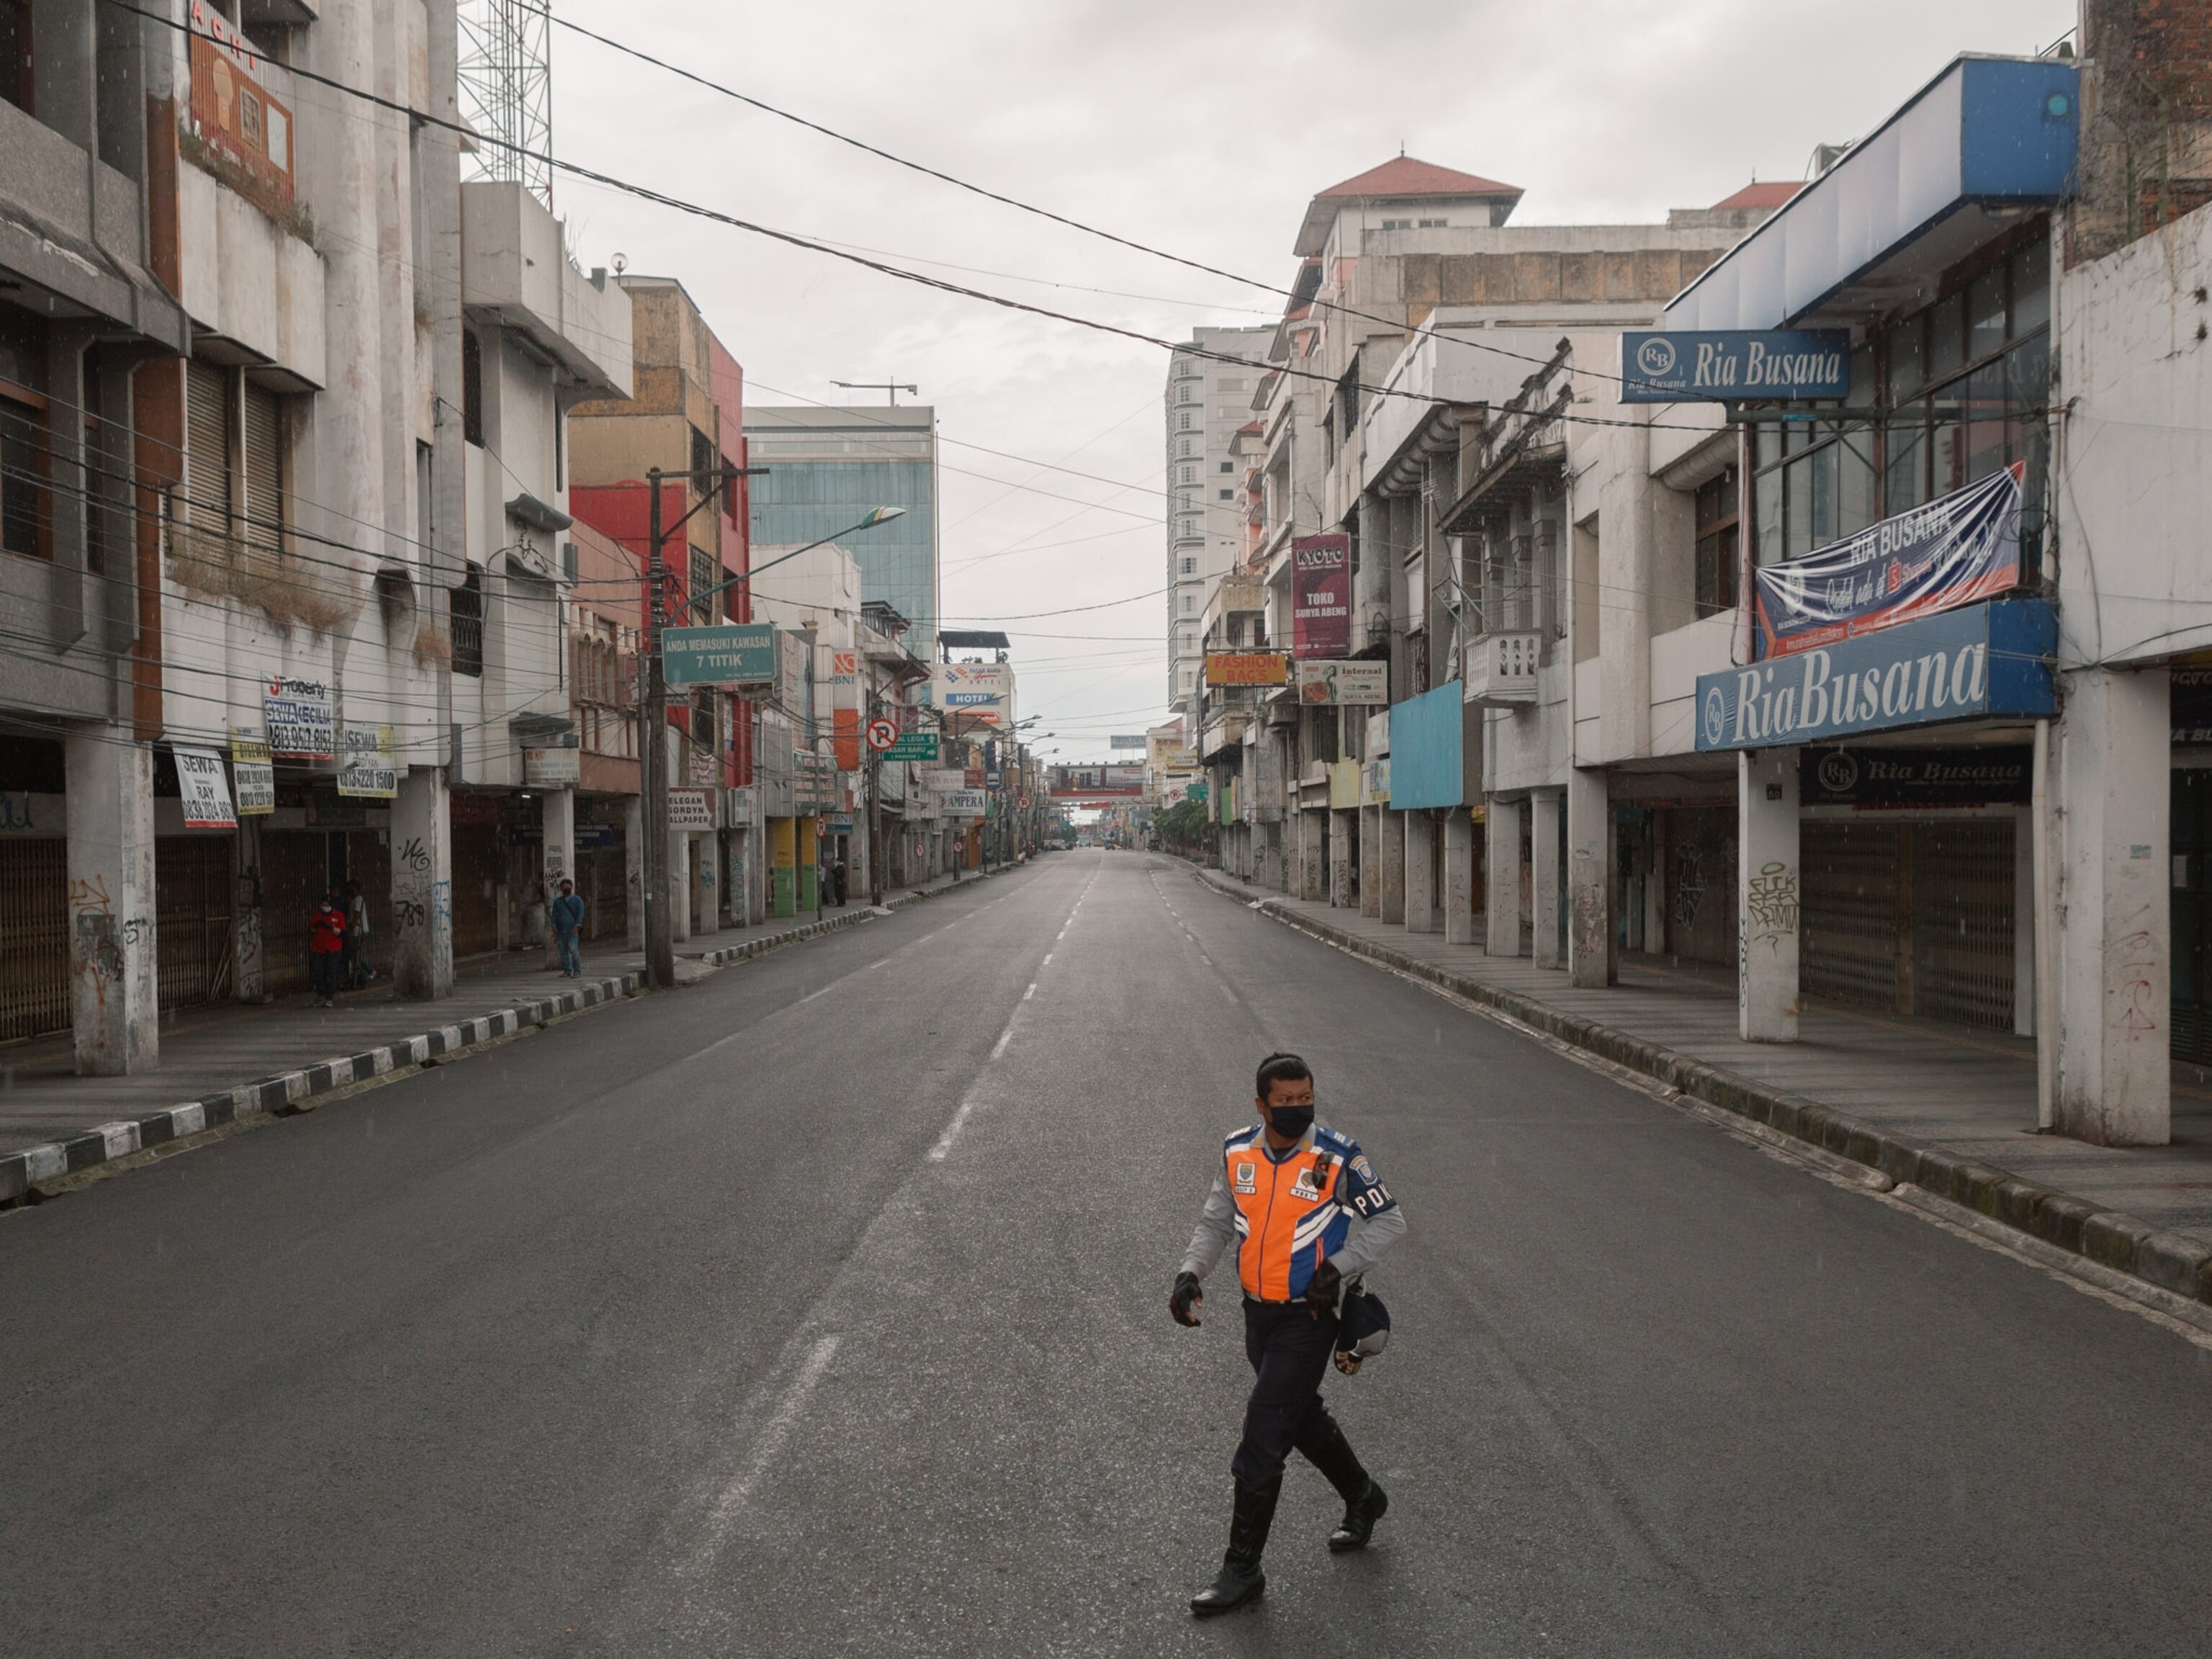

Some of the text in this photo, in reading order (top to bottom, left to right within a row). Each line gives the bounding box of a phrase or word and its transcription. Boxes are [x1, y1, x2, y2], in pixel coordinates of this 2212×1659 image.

[1694, 341, 1840, 387] Ria Busana
[1649, 378, 1686, 388] Busana
[1879, 502, 1954, 557] BUSANA
[1297, 547, 1344, 566] KYOTO
[1306, 591, 1334, 606] TOKO
[1295, 606, 1346, 619] SURYA ABENG
[666, 635, 770, 653] ANDA MEMASUKI KAWASAN
[696, 654, 742, 668] 7 TITIK
[1214, 656, 1278, 668] FASHION
[835, 675, 855, 685] BNI
[1226, 669, 1268, 681] BAG'S
[876, 726, 889, 744] P
[182, 755, 219, 775] SEWA
[1869, 761, 2024, 779] Ria Busana
[196, 786, 215, 801] RAY
[948, 796, 984, 807] AMPERA
